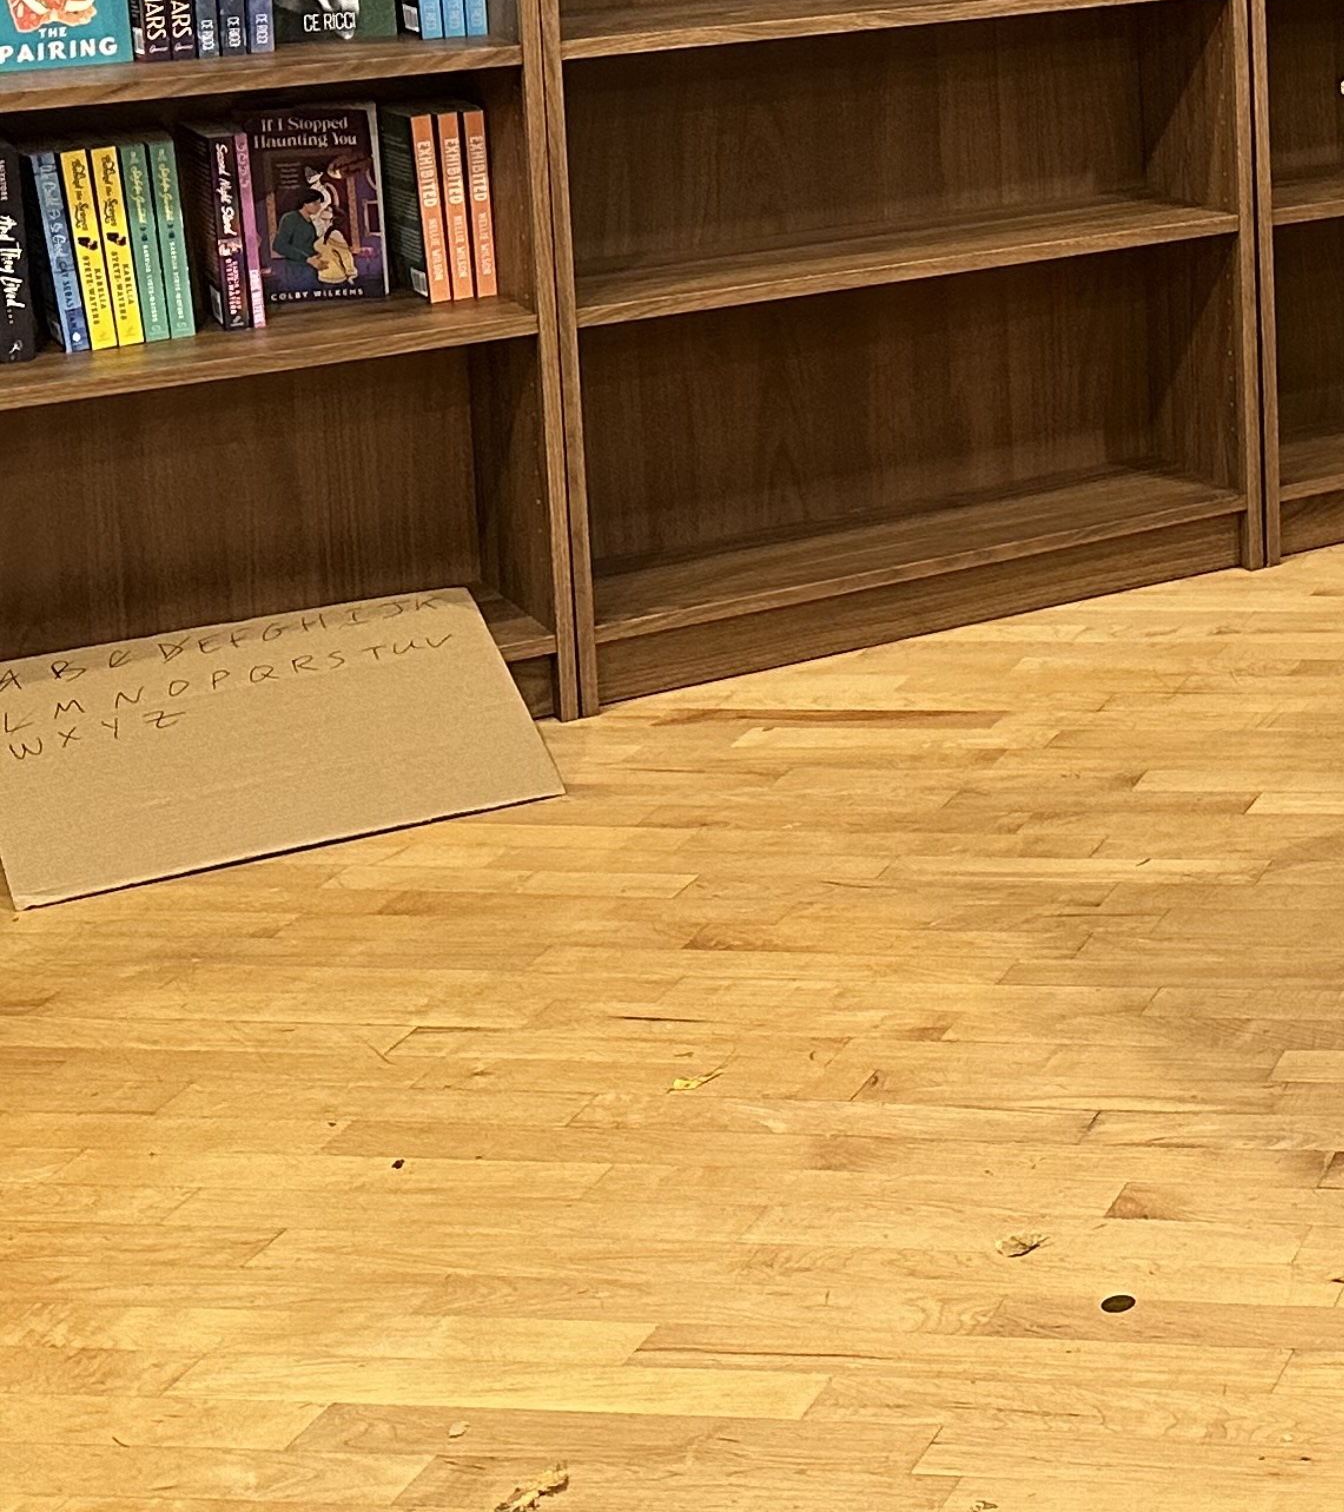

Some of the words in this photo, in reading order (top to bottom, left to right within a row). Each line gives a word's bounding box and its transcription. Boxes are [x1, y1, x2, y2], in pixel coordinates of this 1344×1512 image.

[303, 13, 321, 33] CE
[323, 12, 356, 31] RICCI
[38, 27, 67, 39] THE
[0, 37, 119, 63] PAIRING
[261, 119, 273, 132] If
[278, 119, 283, 132] I
[287, 117, 349, 133] Stopped
[254, 132, 328, 150] Haunting
[331, 132, 357, 146] You
[445, 138, 464, 205] EXHIBITED
[469, 136, 488, 202] EXHIBITED
[270, 290, 308, 302] COLBY
[314, 288, 364, 298] WILKENS
